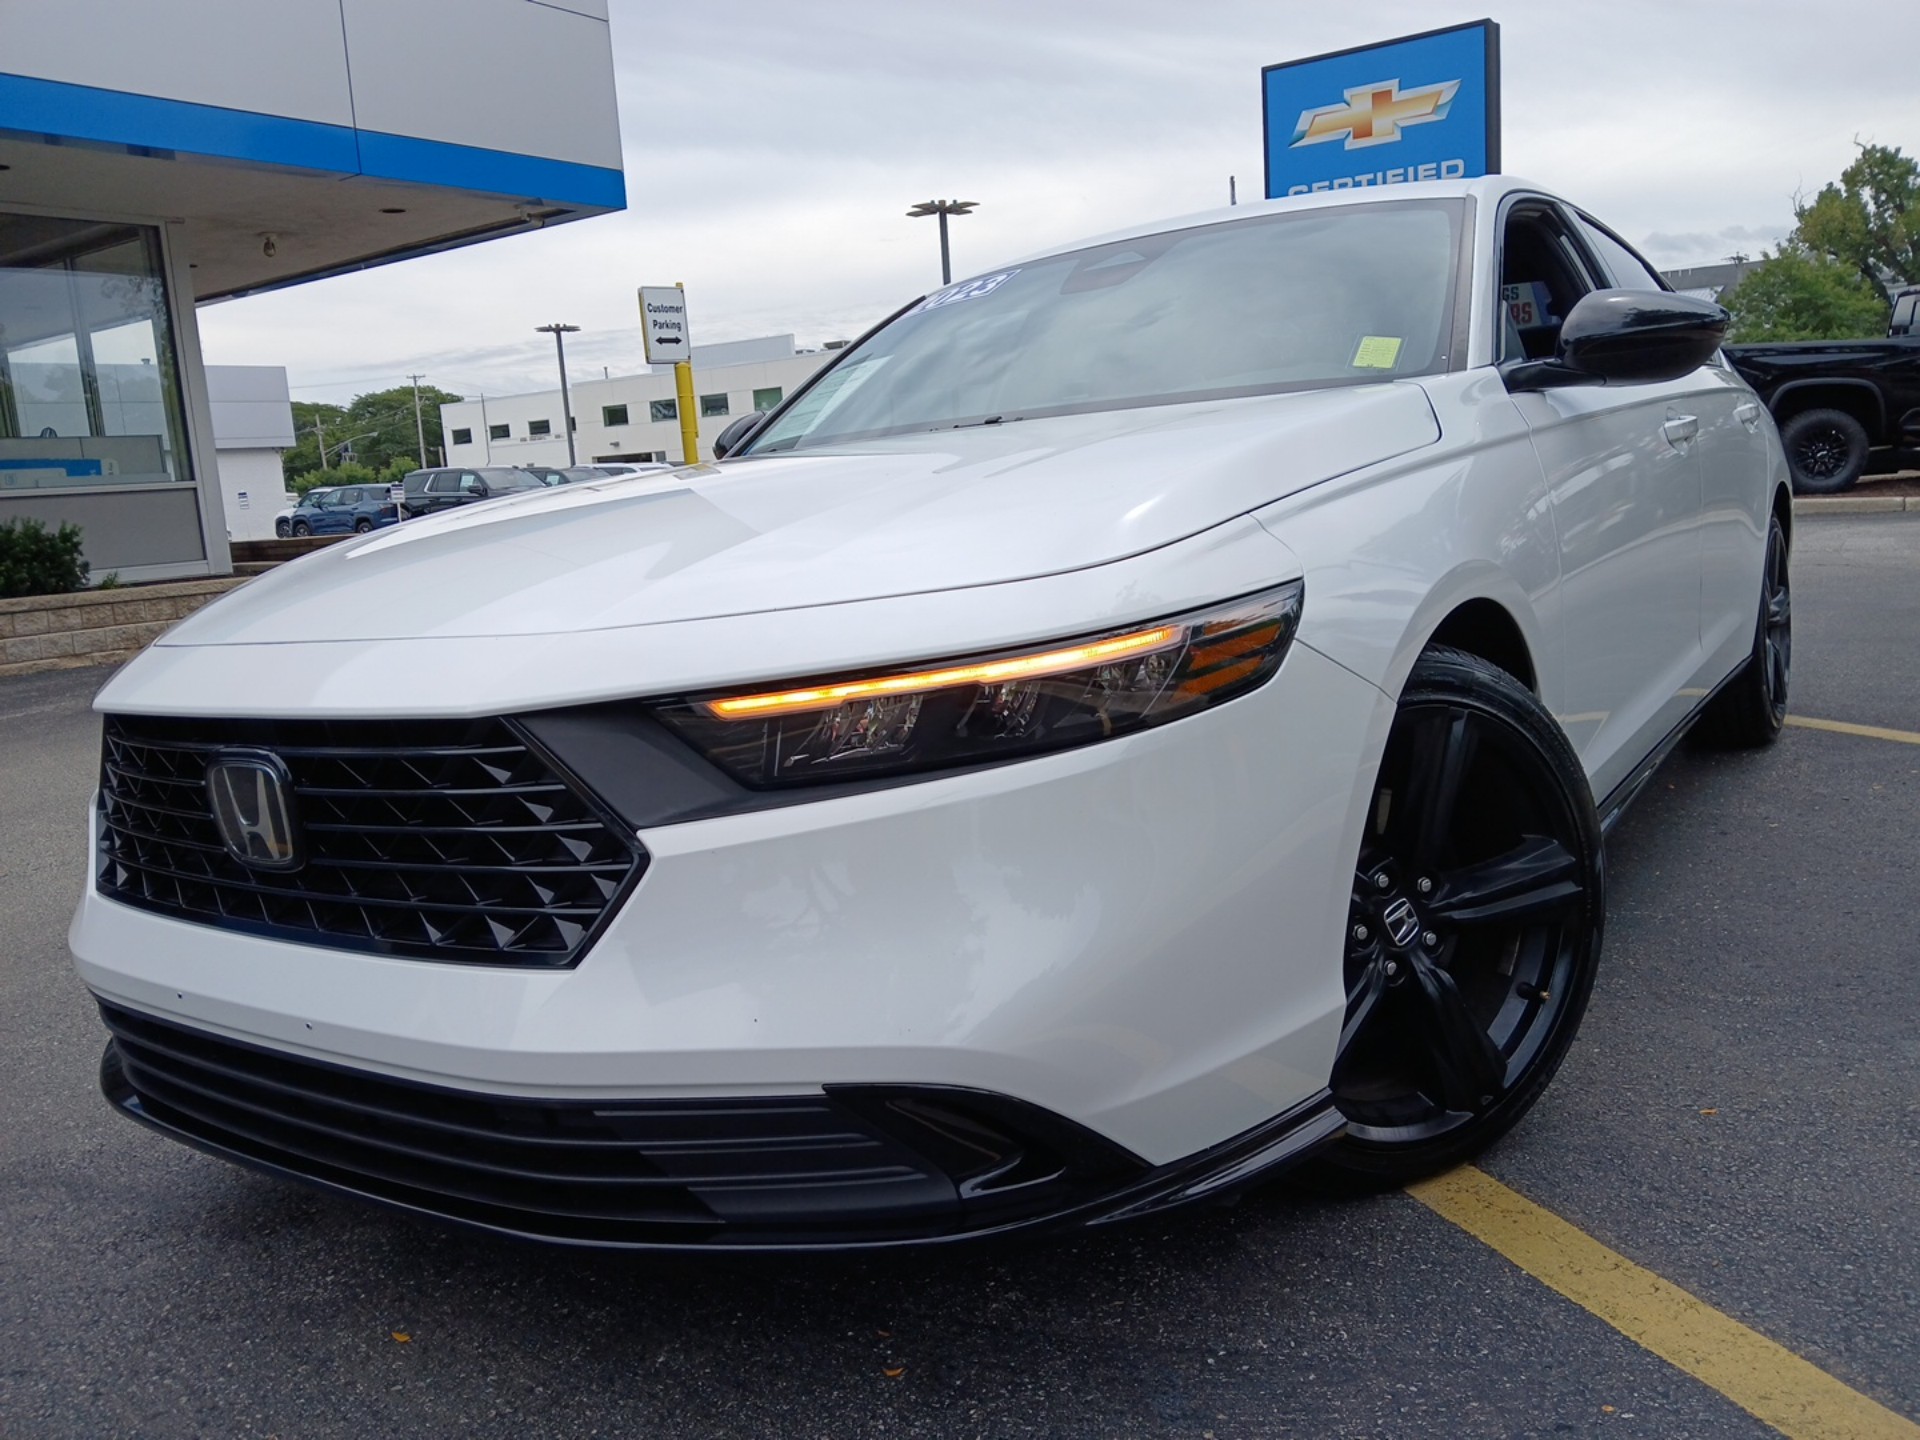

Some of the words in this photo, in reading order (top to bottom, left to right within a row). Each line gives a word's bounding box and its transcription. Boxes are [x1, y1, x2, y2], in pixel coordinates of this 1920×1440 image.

[1288, 159, 1465, 197] CERTIFIED
[647, 302, 683, 314] Customer
[653, 319, 682, 333] Parking
